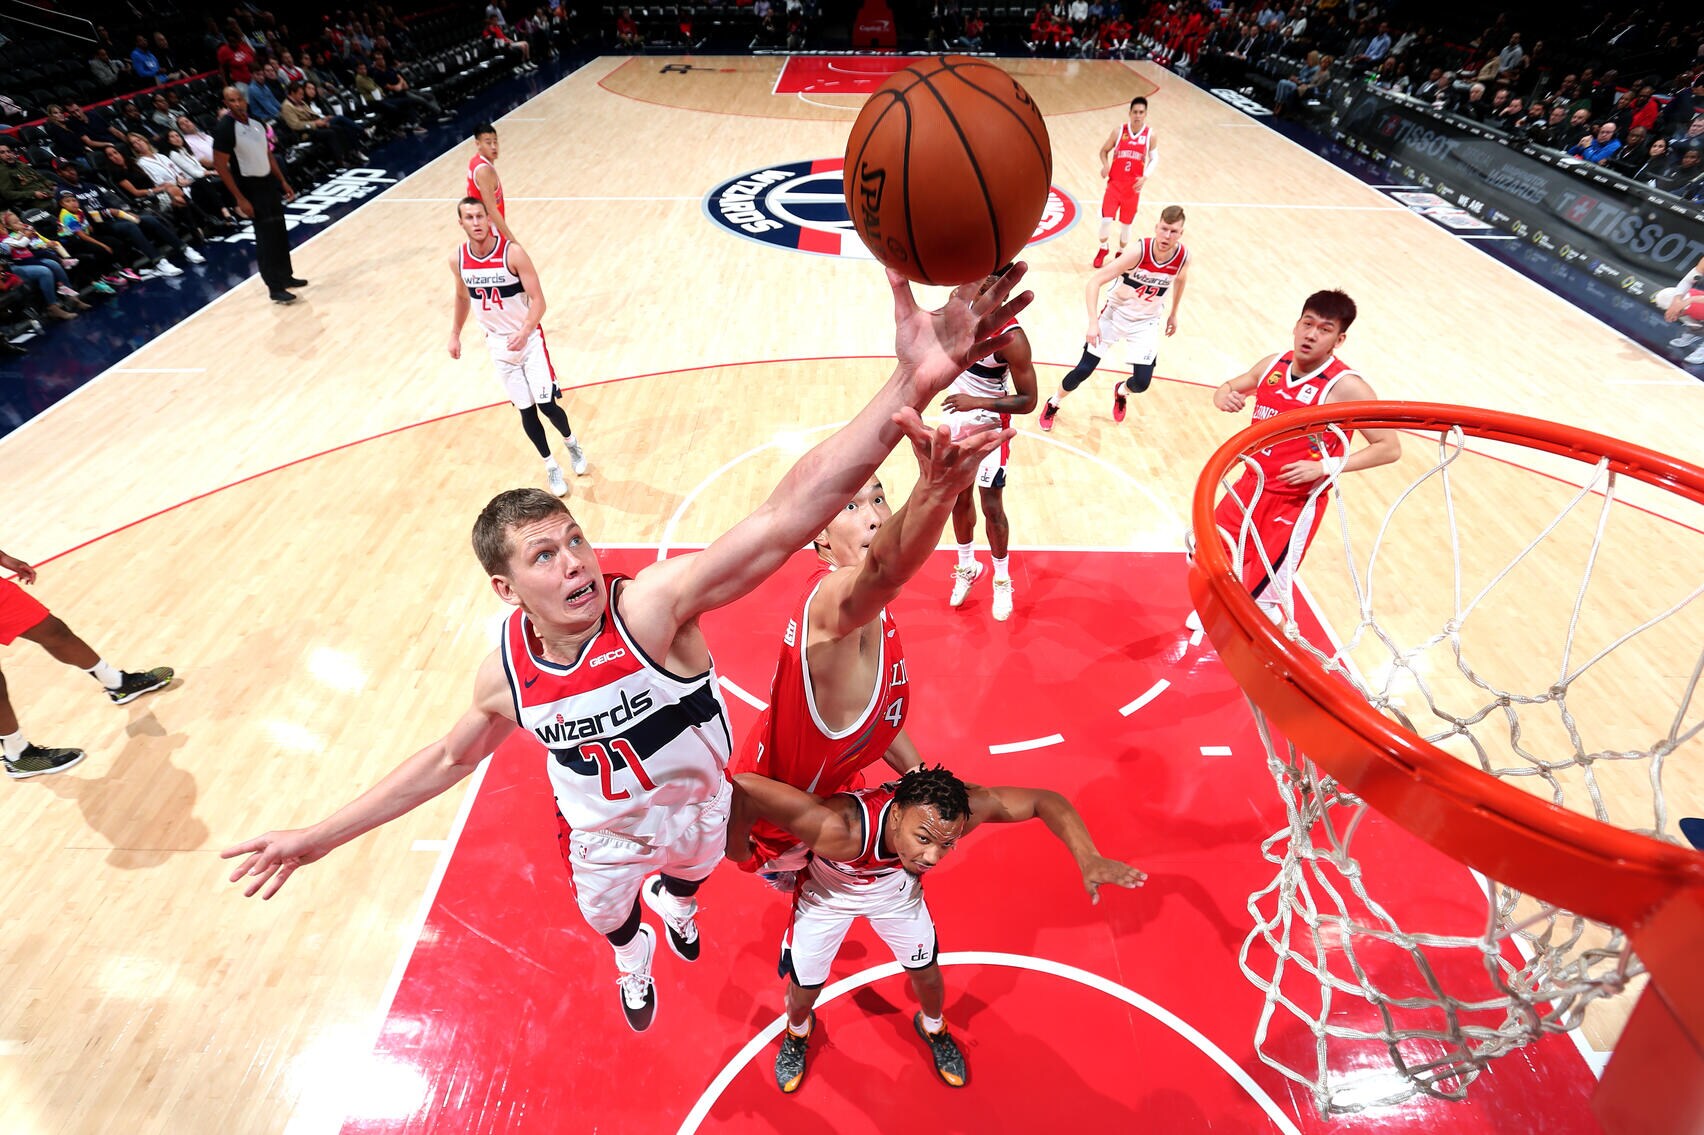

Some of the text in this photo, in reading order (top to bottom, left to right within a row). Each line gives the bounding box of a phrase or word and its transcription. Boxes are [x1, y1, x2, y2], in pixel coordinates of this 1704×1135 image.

[1393, 119, 1460, 162] TISSOT
[1124, 160, 1133, 172] 2
[719, 169, 796, 233] WIZARDS
[1587, 201, 1704, 272] TISSOT
[464, 273, 506, 285] wizards
[1134, 284, 1160, 303] 42
[476, 287, 504, 312] 24
[589, 647, 626, 668] GEICO
[534, 688, 654, 745] wizards
[883, 697, 904, 728] 4
[578, 737, 660, 801] 21
